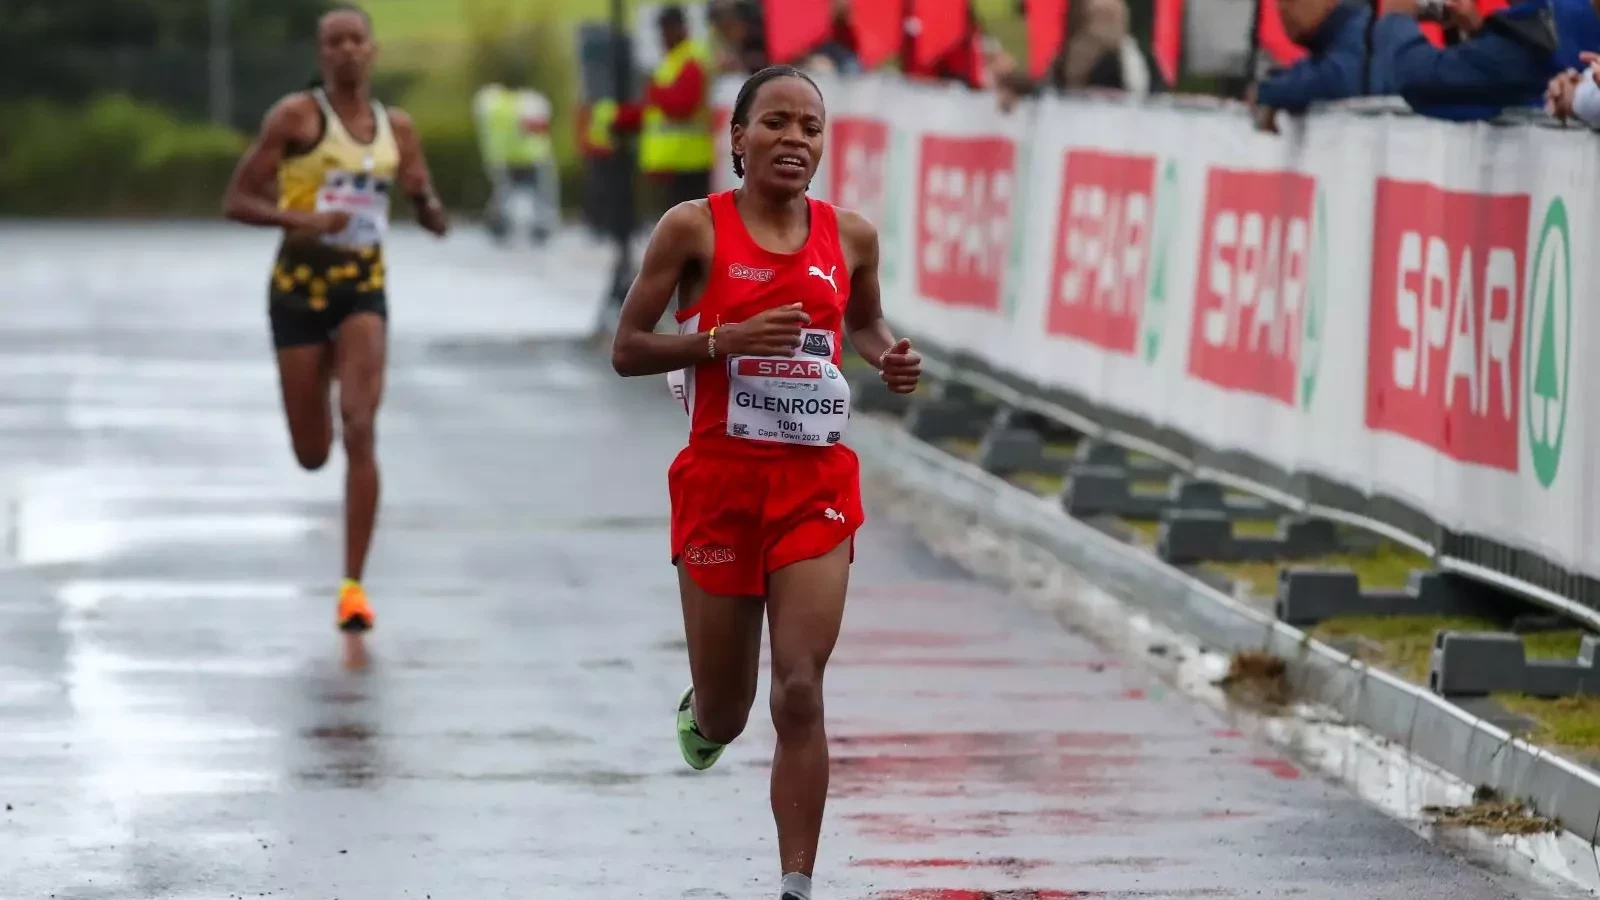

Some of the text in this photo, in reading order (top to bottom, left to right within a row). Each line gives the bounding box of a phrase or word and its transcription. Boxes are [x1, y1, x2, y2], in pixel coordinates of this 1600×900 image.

[1059, 184, 1148, 317] SPAR
[1203, 211, 1307, 360] SPAR
[1392, 231, 1517, 421] SPAR
[806, 335, 828, 347] ASA
[758, 361, 821, 376] SPAR
[735, 391, 845, 415] GLENROSE
[758, 429, 778, 437] Cape
[781, 431, 800, 440] Town
[776, 419, 804, 432] 1001
